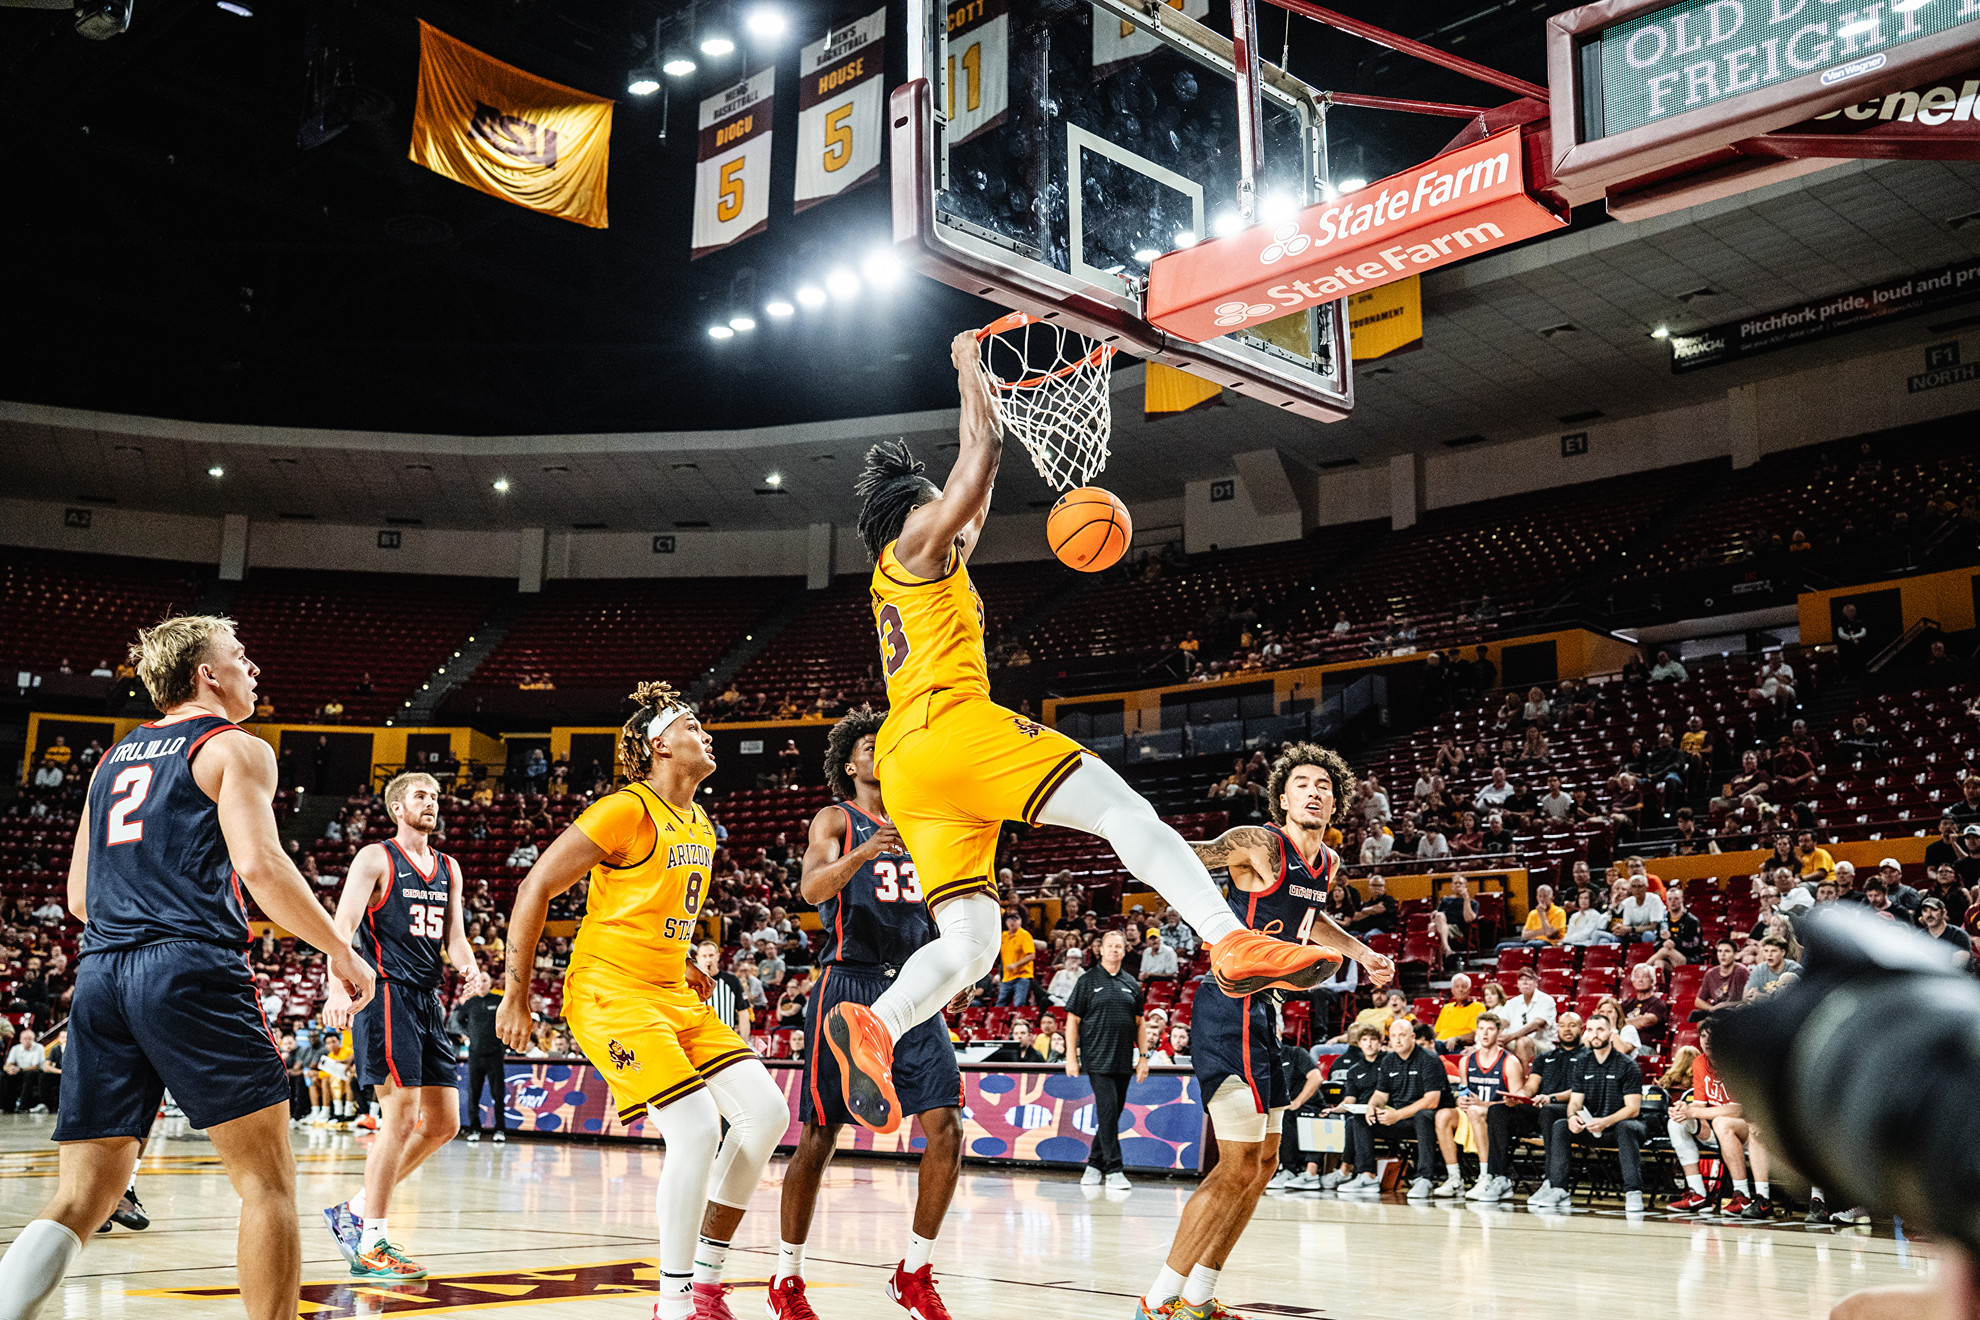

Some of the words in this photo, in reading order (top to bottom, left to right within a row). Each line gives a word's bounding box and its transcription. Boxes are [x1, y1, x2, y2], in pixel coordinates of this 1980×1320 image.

[1625, 0, 1744, 69] OLD
[818, 57, 864, 95] HOUSE
[1826, 69, 1845, 81] Van
[1844, 57, 1882, 75] Wagner
[716, 114, 754, 147] DIOGU
[823, 101, 854, 173] 5
[717, 156, 746, 223] 5
[1740, 306, 1817, 338] Pitchfork
[1818, 296, 1870, 321] pride,
[1872, 281, 1913, 305] loud
[1915, 271, 1951, 293] and
[1931, 347, 1953, 366] F1
[1912, 364, 1975, 391] NORTH
[1565, 436, 1584, 453] E1
[1213, 485, 1232, 499] D1
[109, 737, 186, 765] TRUJILLO
[107, 763, 154, 846] 2
[666, 843, 713, 870] ARIZON
[402, 888, 428, 900] UTAH
[684, 871, 703, 915] 8
[873, 860, 924, 903] 33
[1289, 884, 1313, 900] UTAH
[409, 903, 445, 940] 35
[1296, 906, 1317, 946] 4
